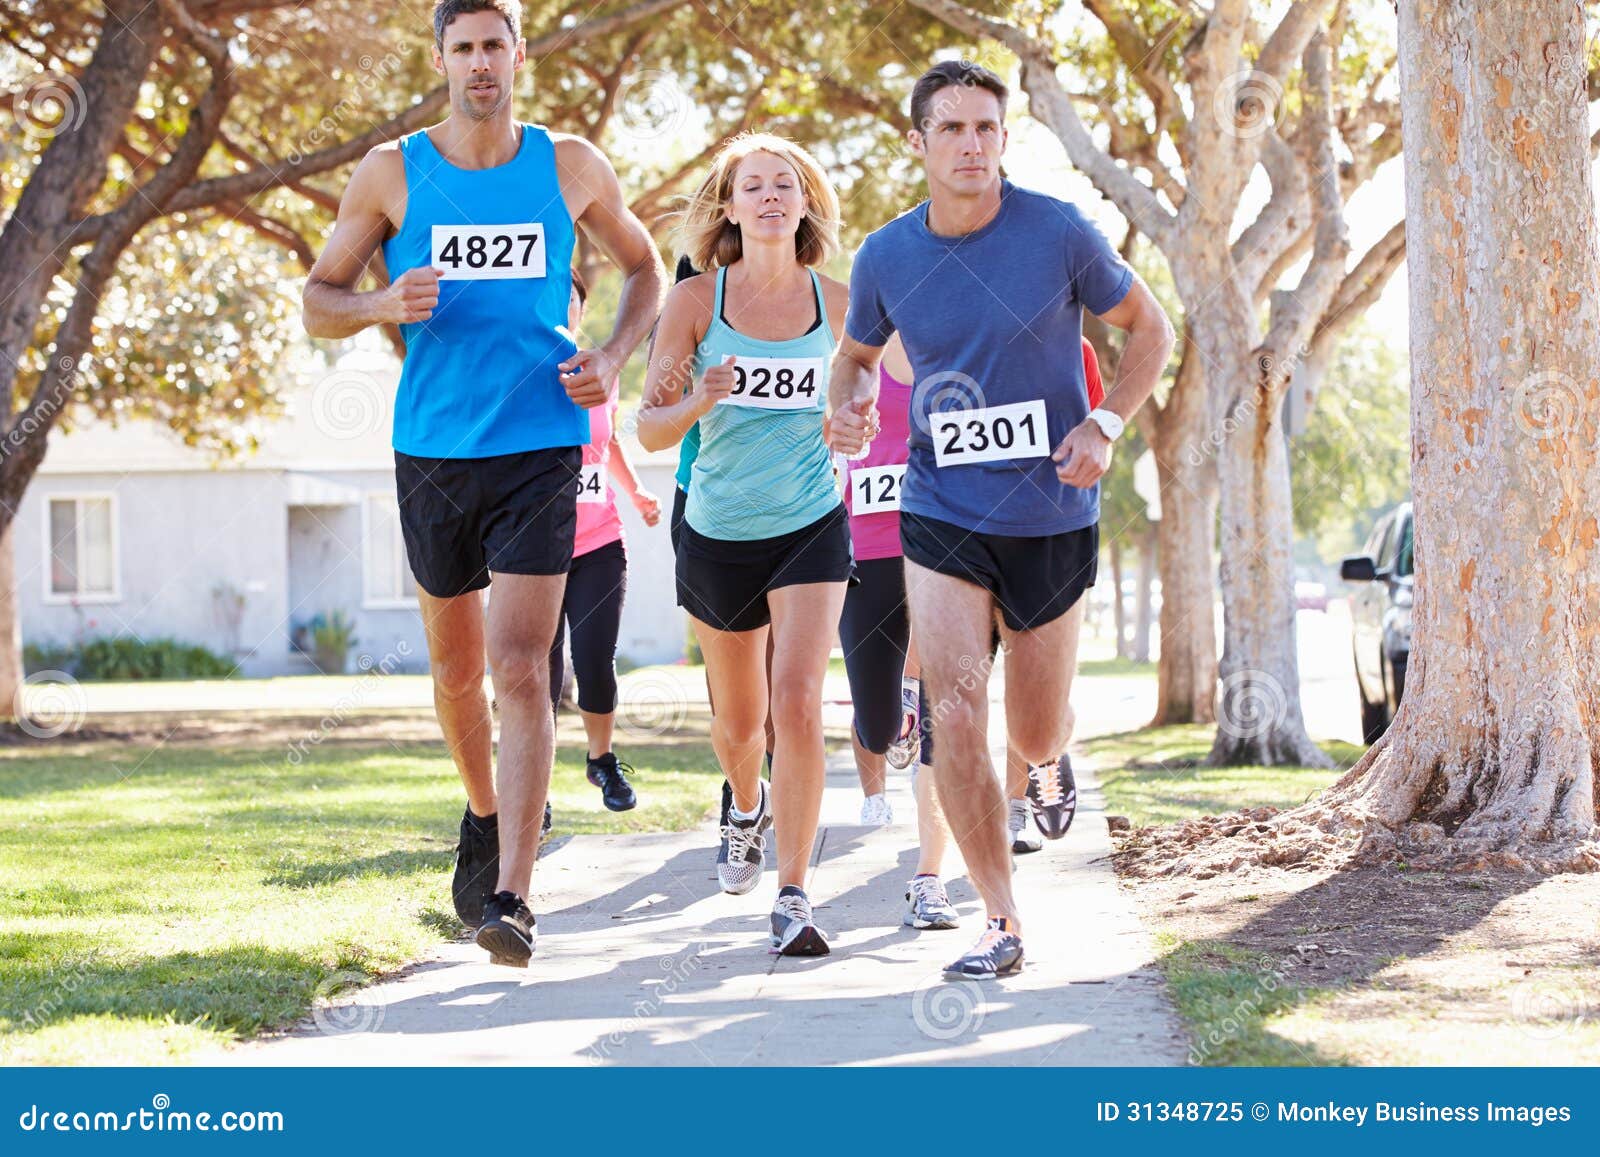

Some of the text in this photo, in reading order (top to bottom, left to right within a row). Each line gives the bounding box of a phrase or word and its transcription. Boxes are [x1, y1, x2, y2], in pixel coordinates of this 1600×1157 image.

[439, 233, 538, 269] 4827
[730, 365, 816, 399] 9284
[940, 413, 1037, 455] 2301
[858, 474, 905, 505] 12
